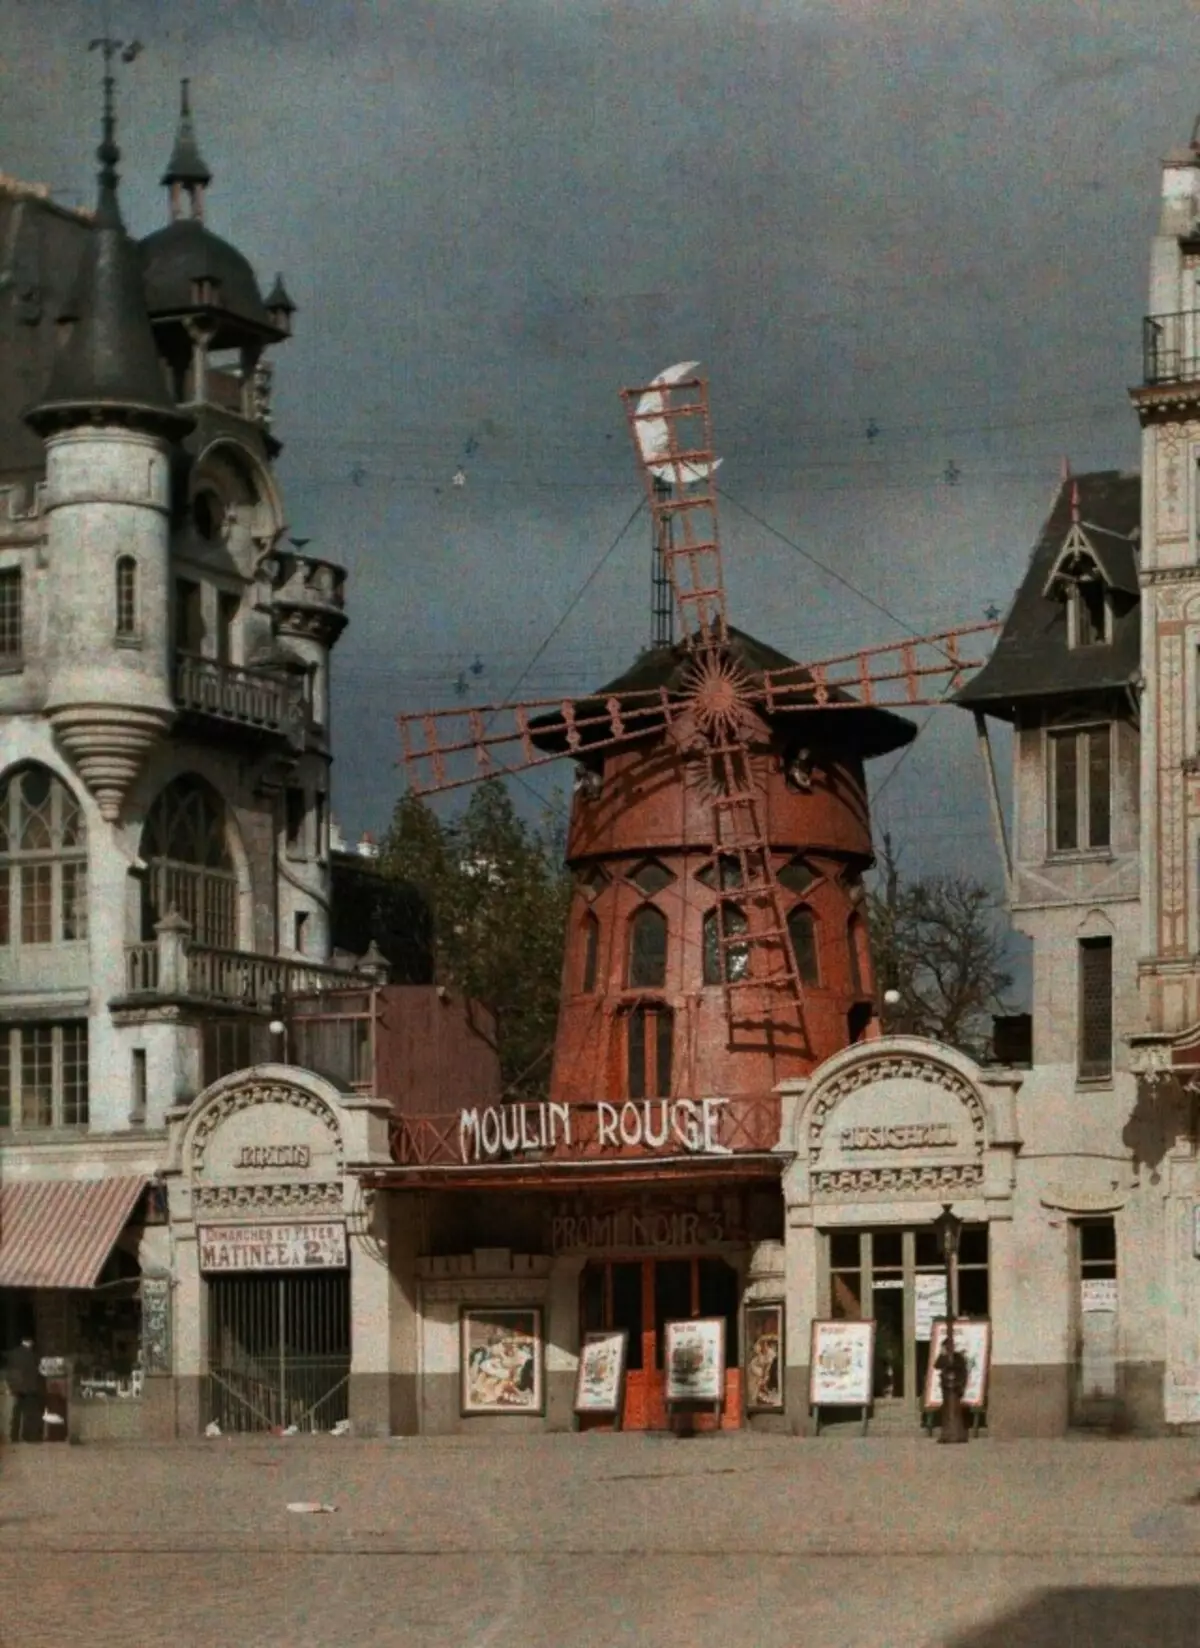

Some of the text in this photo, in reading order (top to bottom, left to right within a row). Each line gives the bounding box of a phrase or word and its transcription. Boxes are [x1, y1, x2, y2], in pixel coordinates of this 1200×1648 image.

[459, 1096, 734, 1164] MOULIN ROUGE
[304, 1240, 324, 1265] 2
